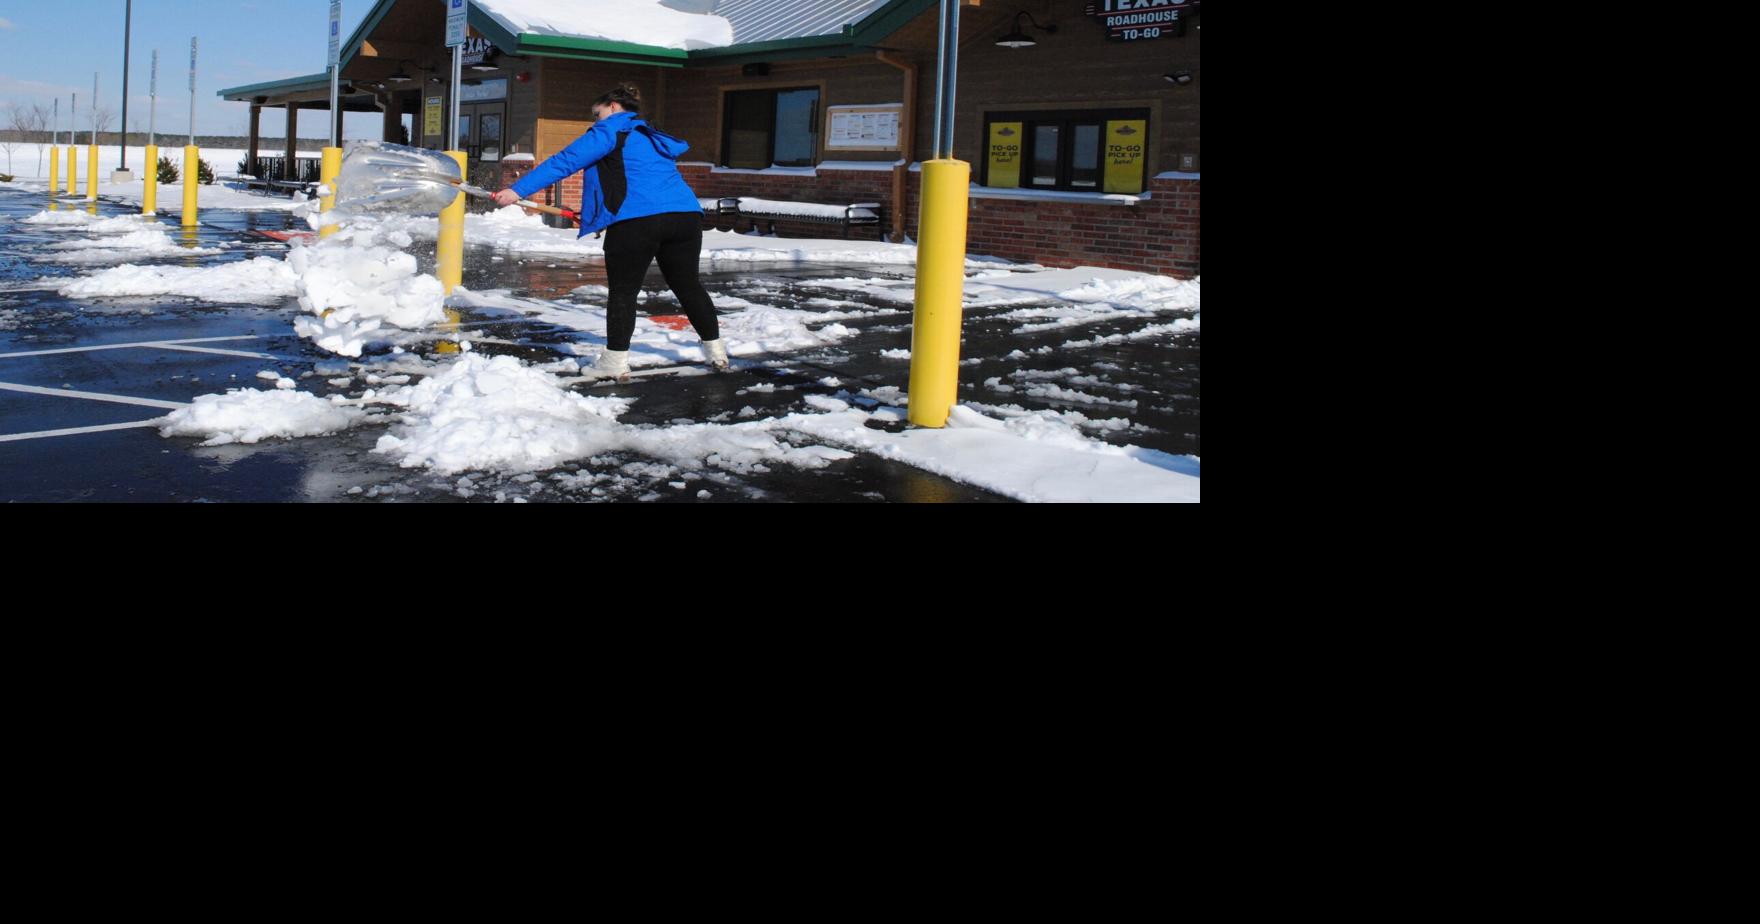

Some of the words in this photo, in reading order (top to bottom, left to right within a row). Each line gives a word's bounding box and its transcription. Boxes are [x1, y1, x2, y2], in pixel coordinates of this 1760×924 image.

[1106, 10, 1179, 26] ROADHOUSE
[1123, 27, 1160, 40] TO-GO
[1109, 144, 1141, 152] TO-GO
